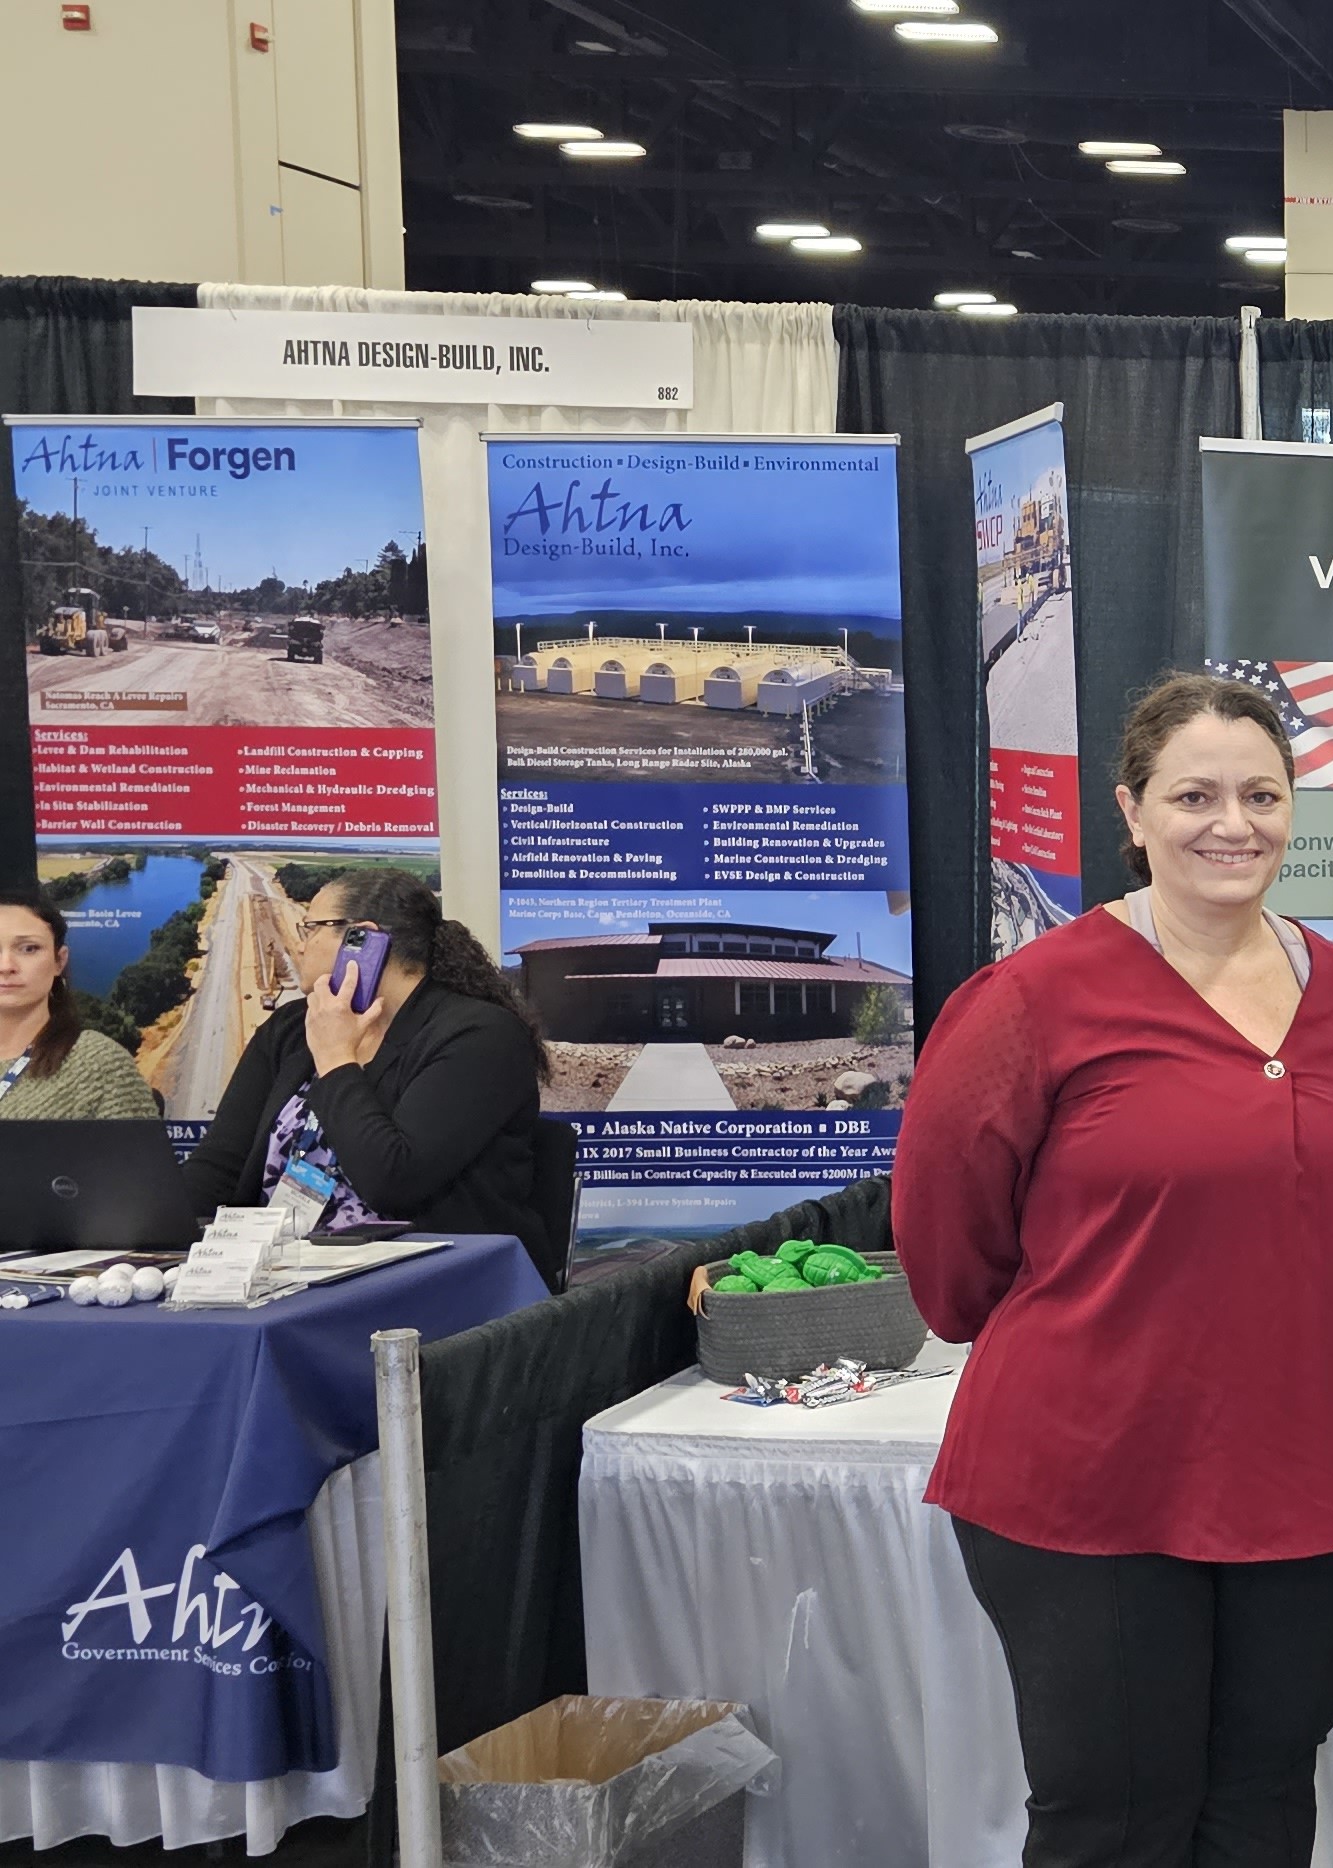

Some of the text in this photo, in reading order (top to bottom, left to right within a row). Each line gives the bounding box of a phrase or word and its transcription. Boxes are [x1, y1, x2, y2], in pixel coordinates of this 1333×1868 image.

[283, 340, 549, 375] AHTNA DESIGN-BUILD, INC.
[658, 388, 678, 401] 882
[22, 434, 295, 479] Ahtna Forgen
[503, 454, 879, 473] Construction Design-Build Environmental
[93, 485, 218, 497] JOINT VENTURE
[503, 478, 692, 535] Ahtna
[504, 538, 689, 560] Design-Build, Inc.
[34, 730, 88, 741] Services:
[38, 746, 188, 755] Levee Dam Rehabilitation
[244, 746, 423, 759] Landfill Construction Capping
[39, 764, 213, 774] Habitat Wetland Construction
[245, 765, 336, 776] Mine Reclamation
[39, 782, 190, 793] Environmental Remediation
[246, 783, 434, 797] Mechanical Hydraulic Dredging
[501, 789, 547, 799] Services:
[41, 801, 148, 811] In Situ Stabilization
[246, 802, 345, 814] Forest Management
[511, 804, 574, 815] Design-Build
[713, 805, 836, 814] SWPPP BMP Services
[41, 820, 182, 830] Barrier Wall Construction
[248, 821, 434, 833] Disaster Recovery / Debris Removal
[511, 820, 683, 830] Vertical/Horizontal Construction
[713, 821, 859, 831] Environmental Remediation
[511, 837, 609, 846] Civil Infrastructure
[713, 838, 885, 849] Building Renovation Upgrades
[512, 853, 662, 864] Airfield Renovation Paving
[714, 854, 888, 866] Marine Construction Dredging
[512, 870, 677, 881] Demolition Decommissioning
[714, 871, 865, 882] EVSE Design Construction
[602, 1121, 870, 1137] Alaska Native Corporation DBE
[583, 1148, 599, 1158] IX
[603, 1148, 632, 1158] 2017
[636, 1146, 670, 1158] Small
[675, 1146, 728, 1157] Business
[732, 1146, 799, 1157] Contractor
[802, 1146, 816, 1157] of
[818, 1146, 836, 1157] the
[840, 1146, 868, 1157] Year
[593, 1169, 870, 1181] Billion in Contract Capacity & Executed over $200M in
[62, 1642, 189, 1661] Government
